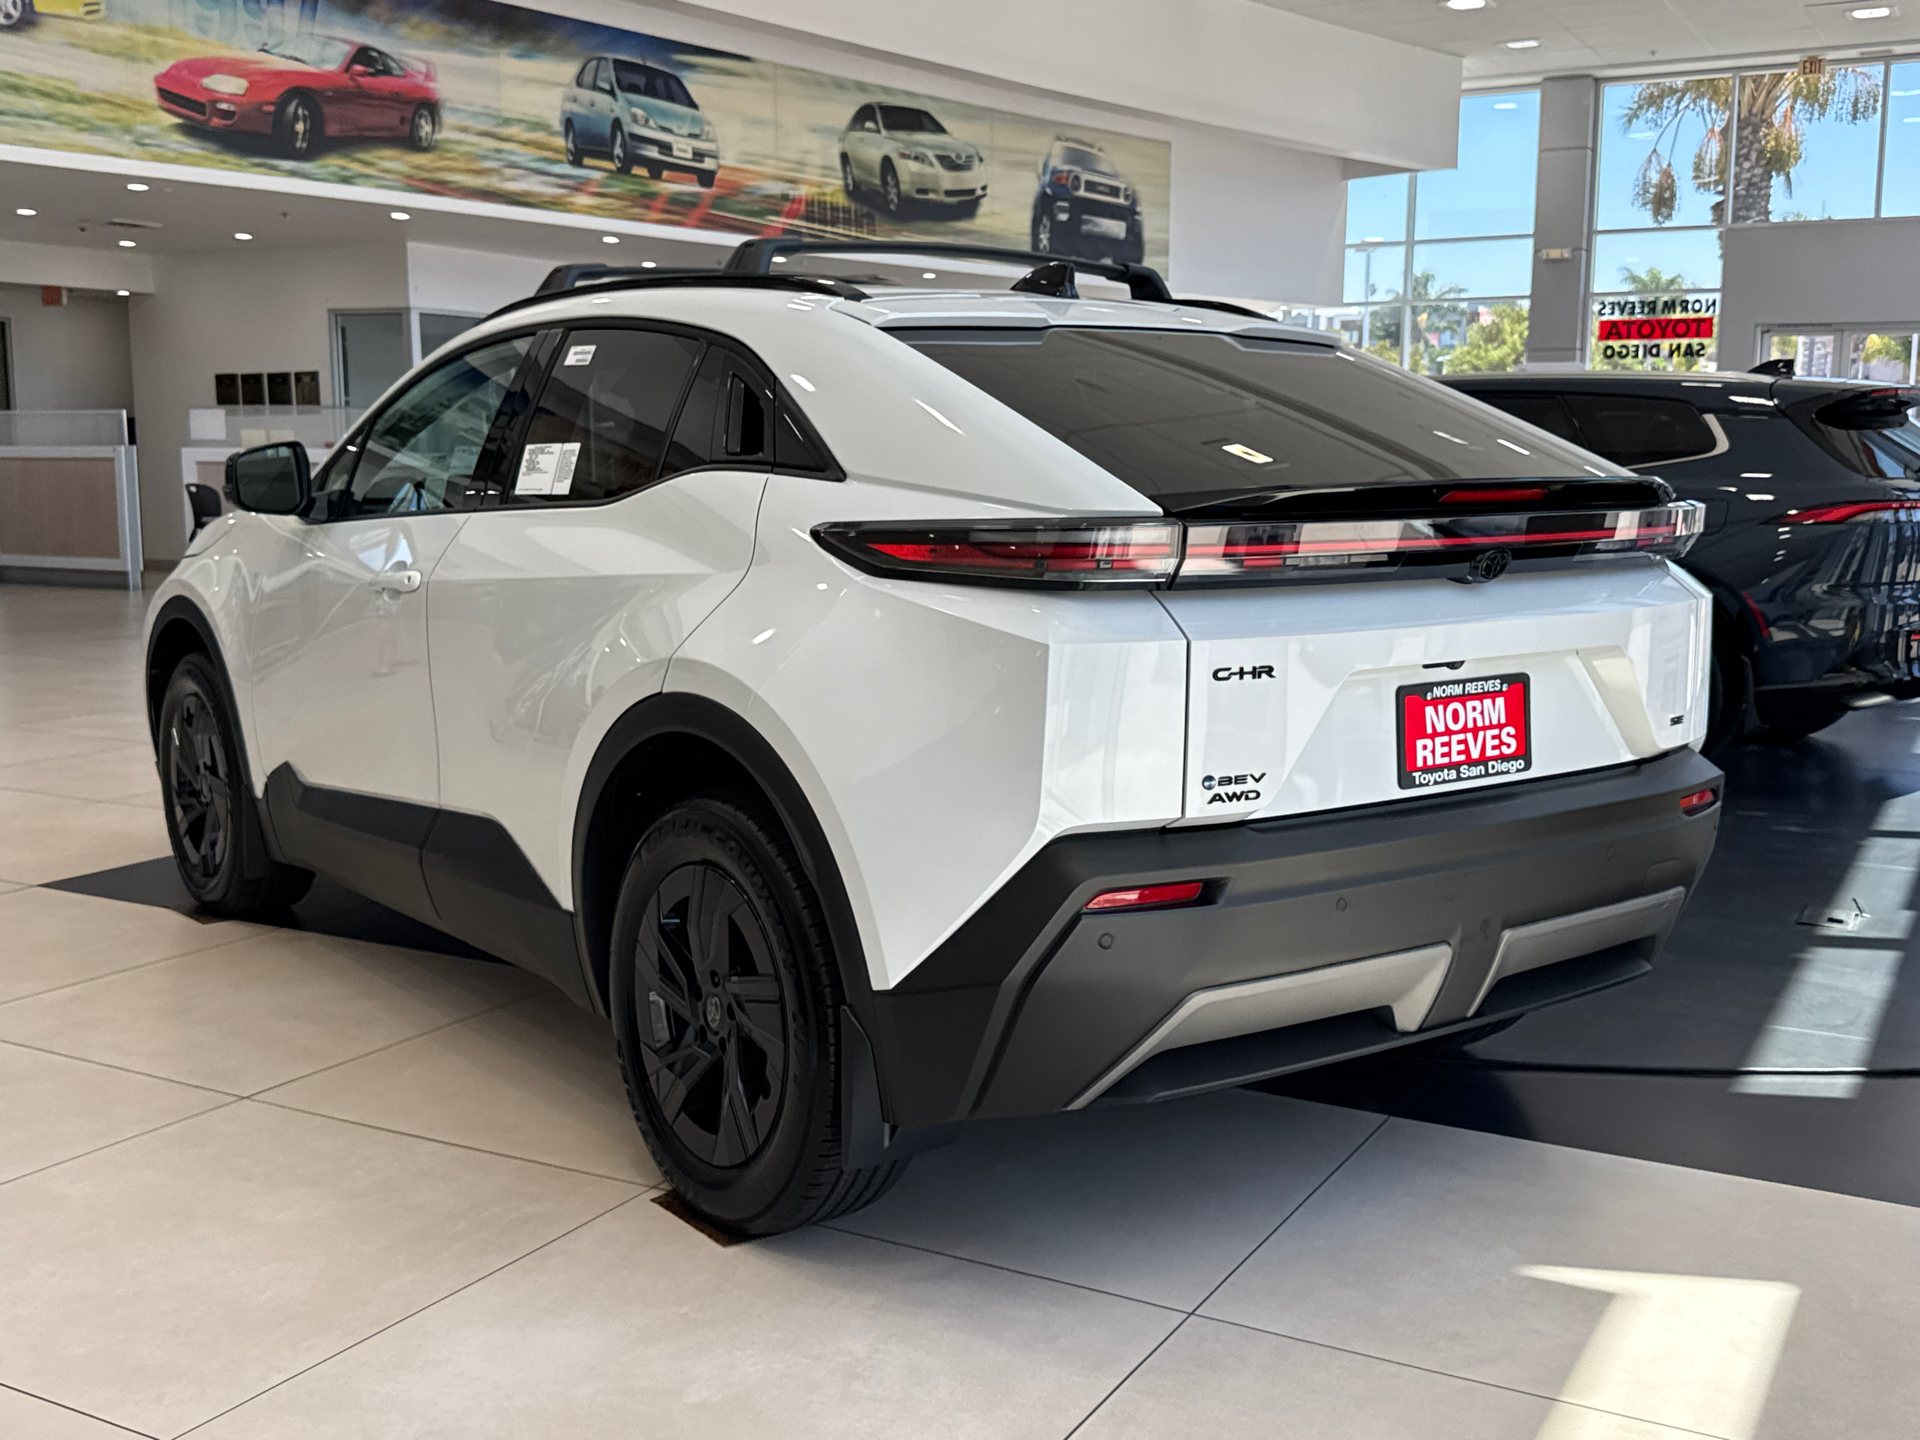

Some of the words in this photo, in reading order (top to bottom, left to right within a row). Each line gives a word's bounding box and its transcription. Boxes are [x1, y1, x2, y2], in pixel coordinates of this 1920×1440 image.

[1802, 59, 1822, 74] EXIT
[1212, 665, 1276, 681] C-HR
[1433, 685, 1462, 697] NORM
[1465, 680, 1501, 693] REEVES
[1424, 697, 1506, 734] NORM
[1416, 726, 1516, 767] REEVES
[1217, 772, 1267, 787] BEV
[1413, 770, 1456, 785] Toyota
[1459, 765, 1485, 779] San
[1488, 760, 1524, 773] Diego
[1207, 790, 1261, 804] AWD
